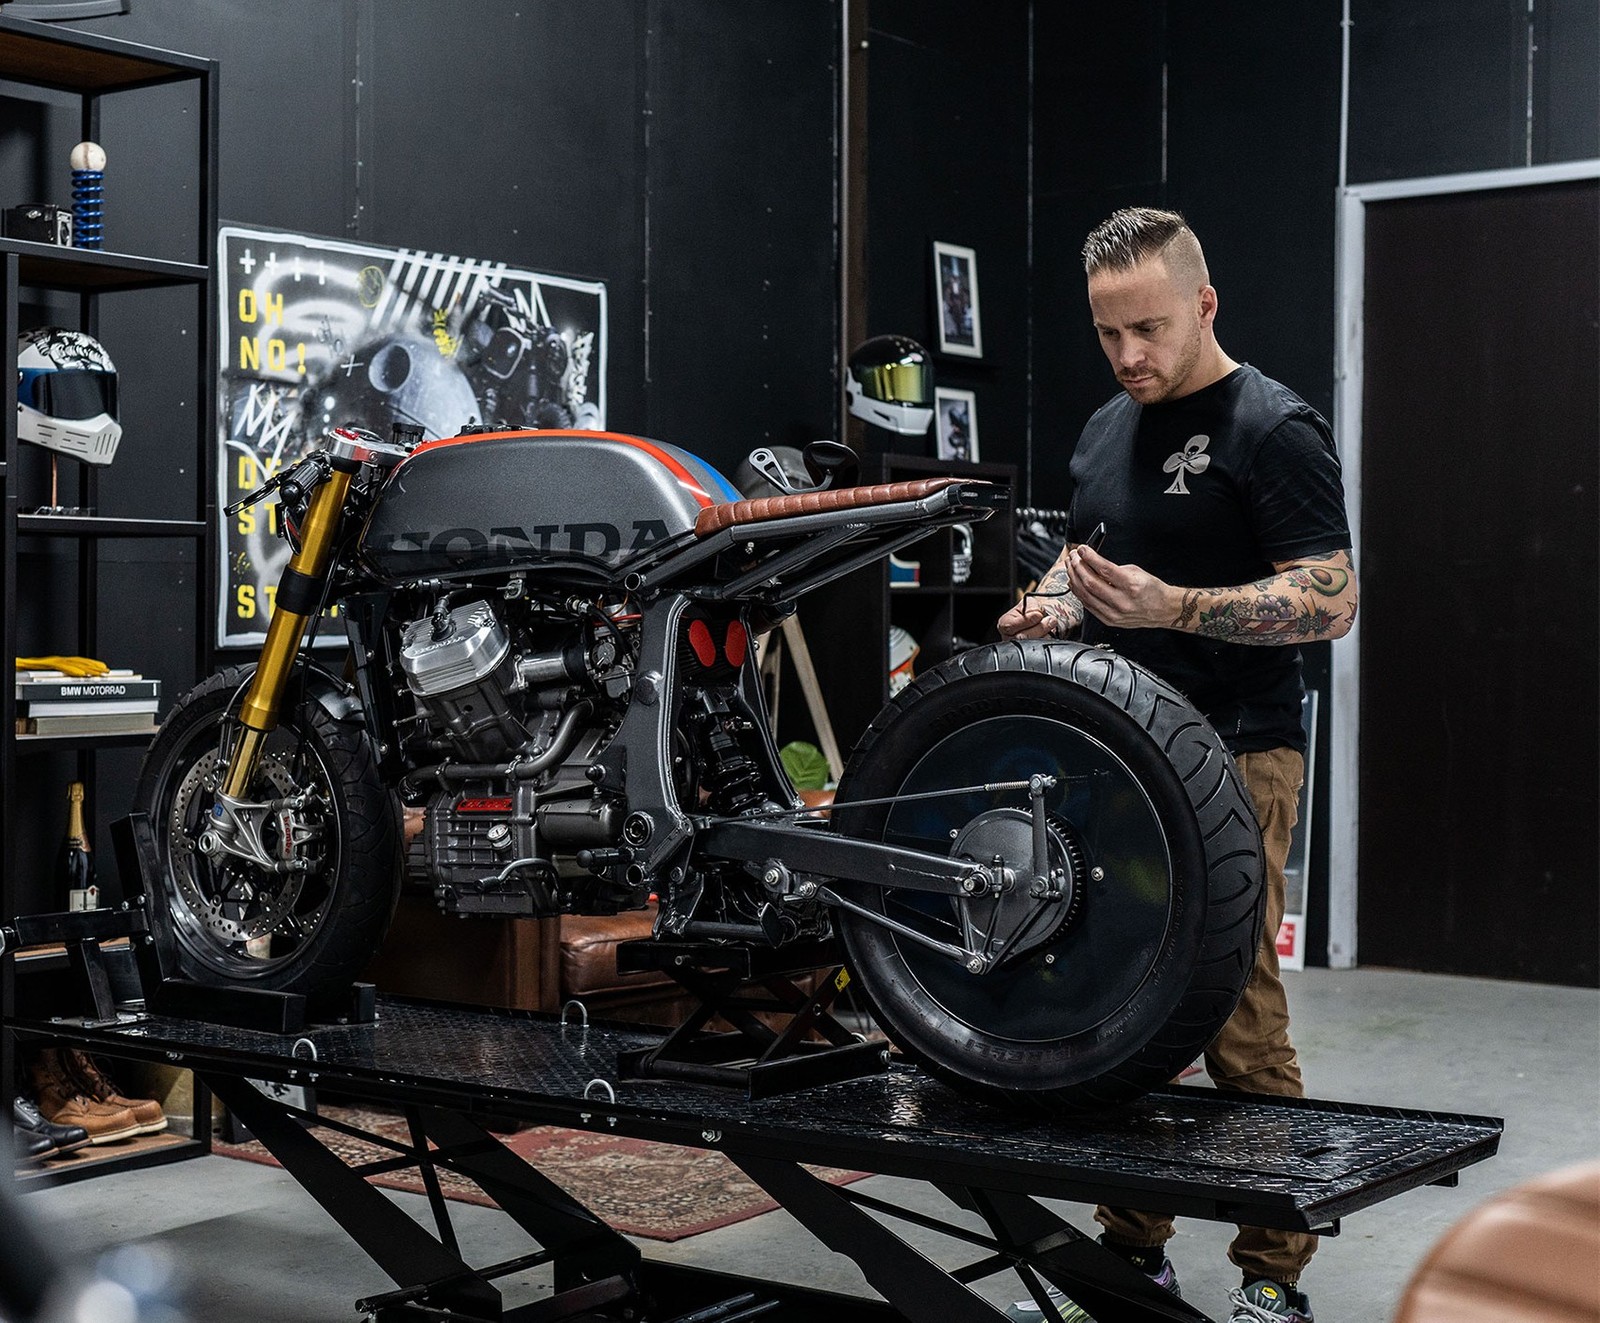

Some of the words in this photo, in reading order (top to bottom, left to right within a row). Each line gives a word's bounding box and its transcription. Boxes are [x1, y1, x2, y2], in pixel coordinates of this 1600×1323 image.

[239, 289, 283, 326] OH
[240, 336, 307, 375] NO!
[238, 456, 301, 490] DE
[61, 686, 81, 696] BMW
[83, 686, 126, 695] MOTORRAD
